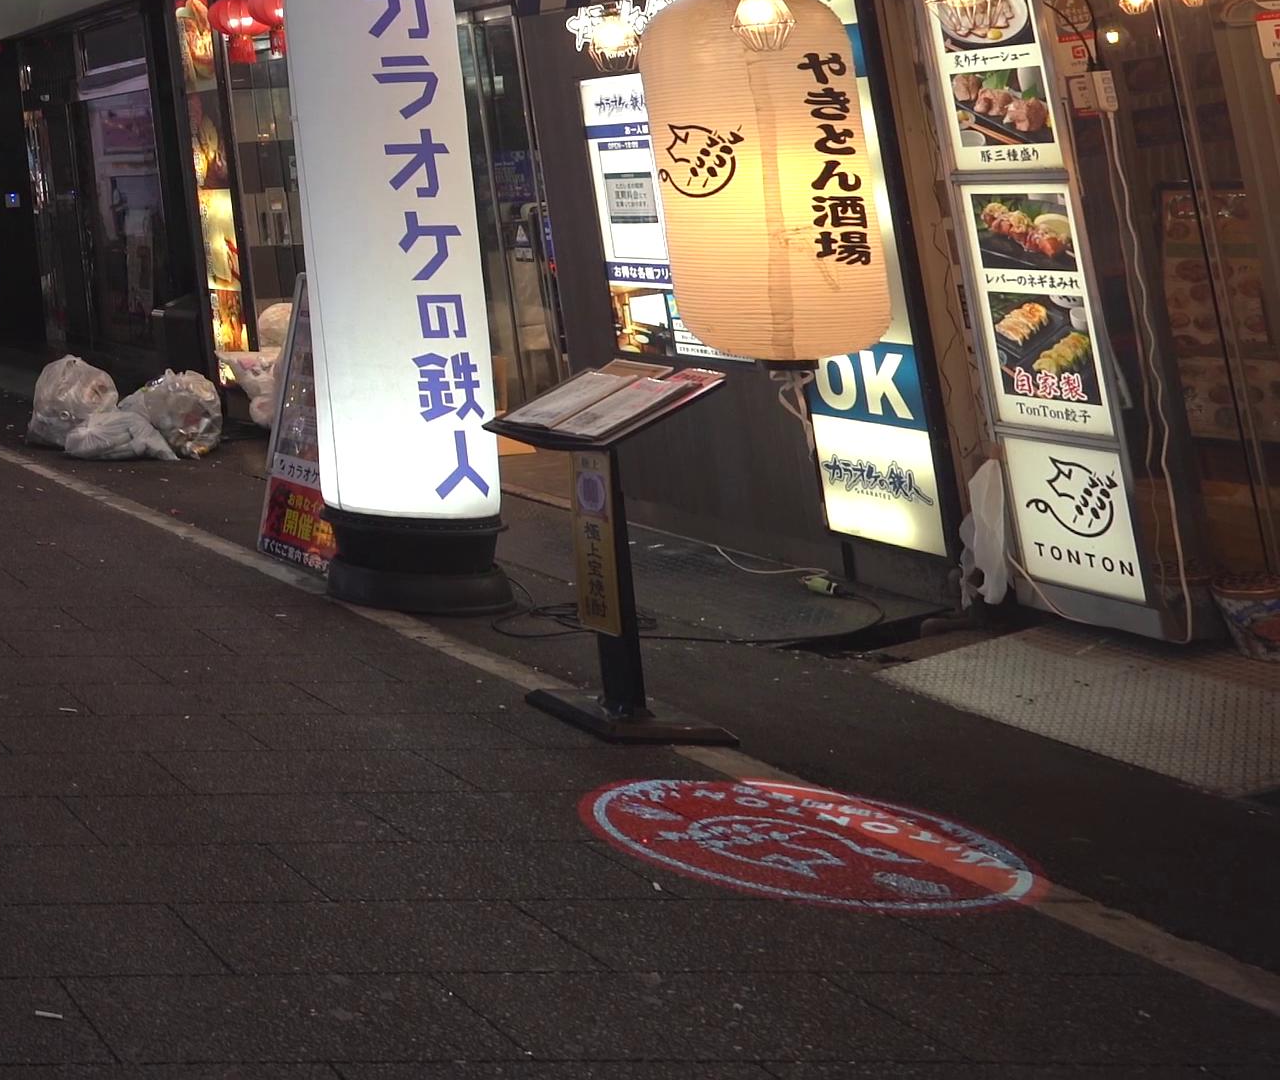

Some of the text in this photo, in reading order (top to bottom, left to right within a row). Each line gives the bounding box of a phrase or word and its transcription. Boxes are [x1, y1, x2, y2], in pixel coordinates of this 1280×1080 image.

[953, 50, 1031, 69] 炙りチャーシュー
[797, 51, 872, 266] やきとん酒場
[980, 148, 1040, 164] 豚三種盛り
[612, 265, 673, 281] お得な各種フリ
[984, 272, 1080, 291] レバーのネギまみれ
[817, 350, 914, 422] OK
[1012, 368, 1088, 402] 自家製
[1014, 400, 1092, 426] TonTon餃子
[824, 455, 934, 507] カラオケの鉄人
[1034, 540, 1135, 577] TONTON
